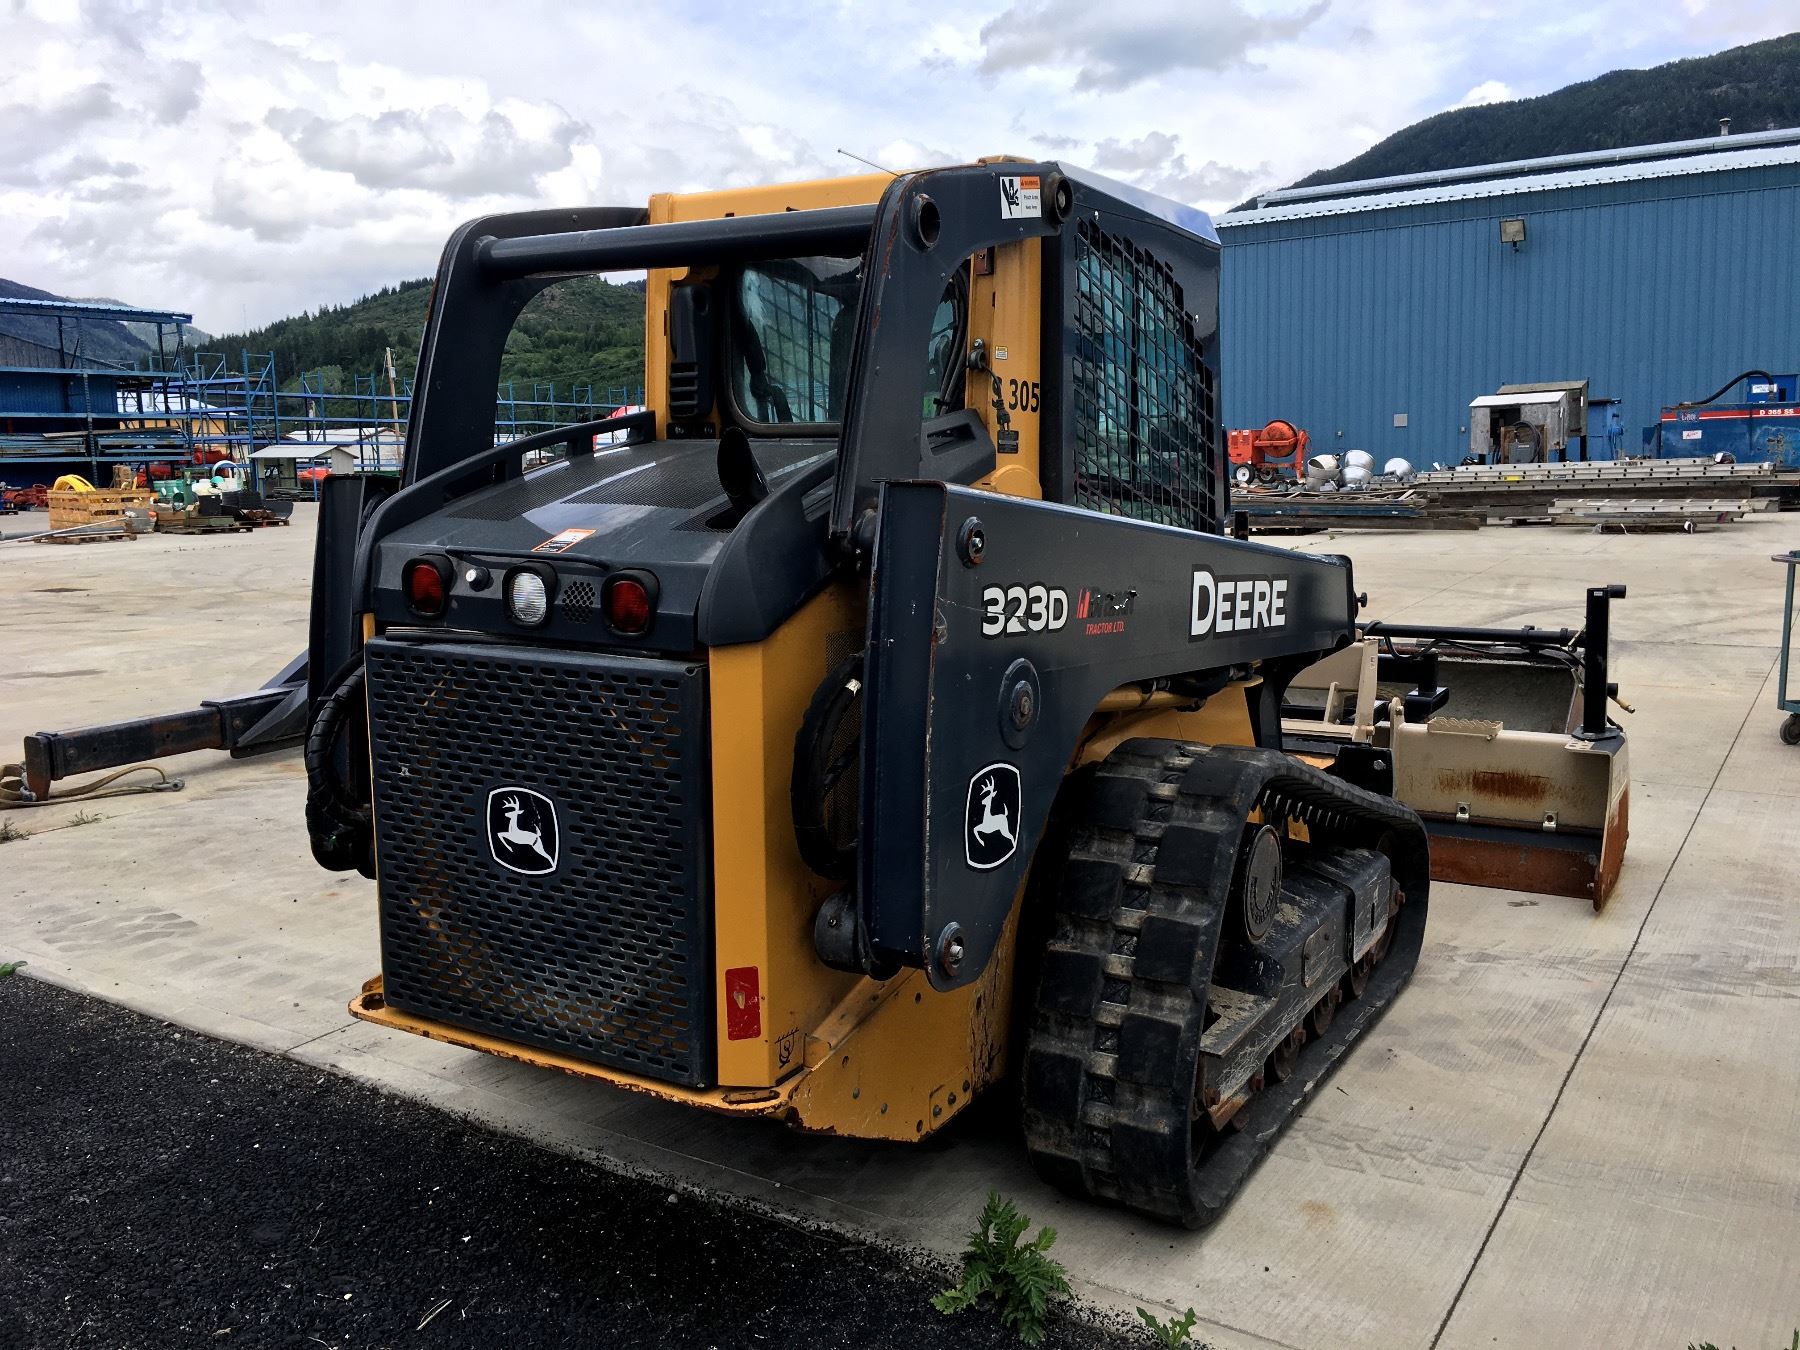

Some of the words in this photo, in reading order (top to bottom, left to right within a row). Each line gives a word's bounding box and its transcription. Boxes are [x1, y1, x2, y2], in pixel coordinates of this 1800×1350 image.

[1008, 378, 1040, 413] 305
[982, 585, 1069, 636] 323D
[1191, 571, 1288, 636] DEERE
[1086, 621, 1113, 636] TRACTOR
